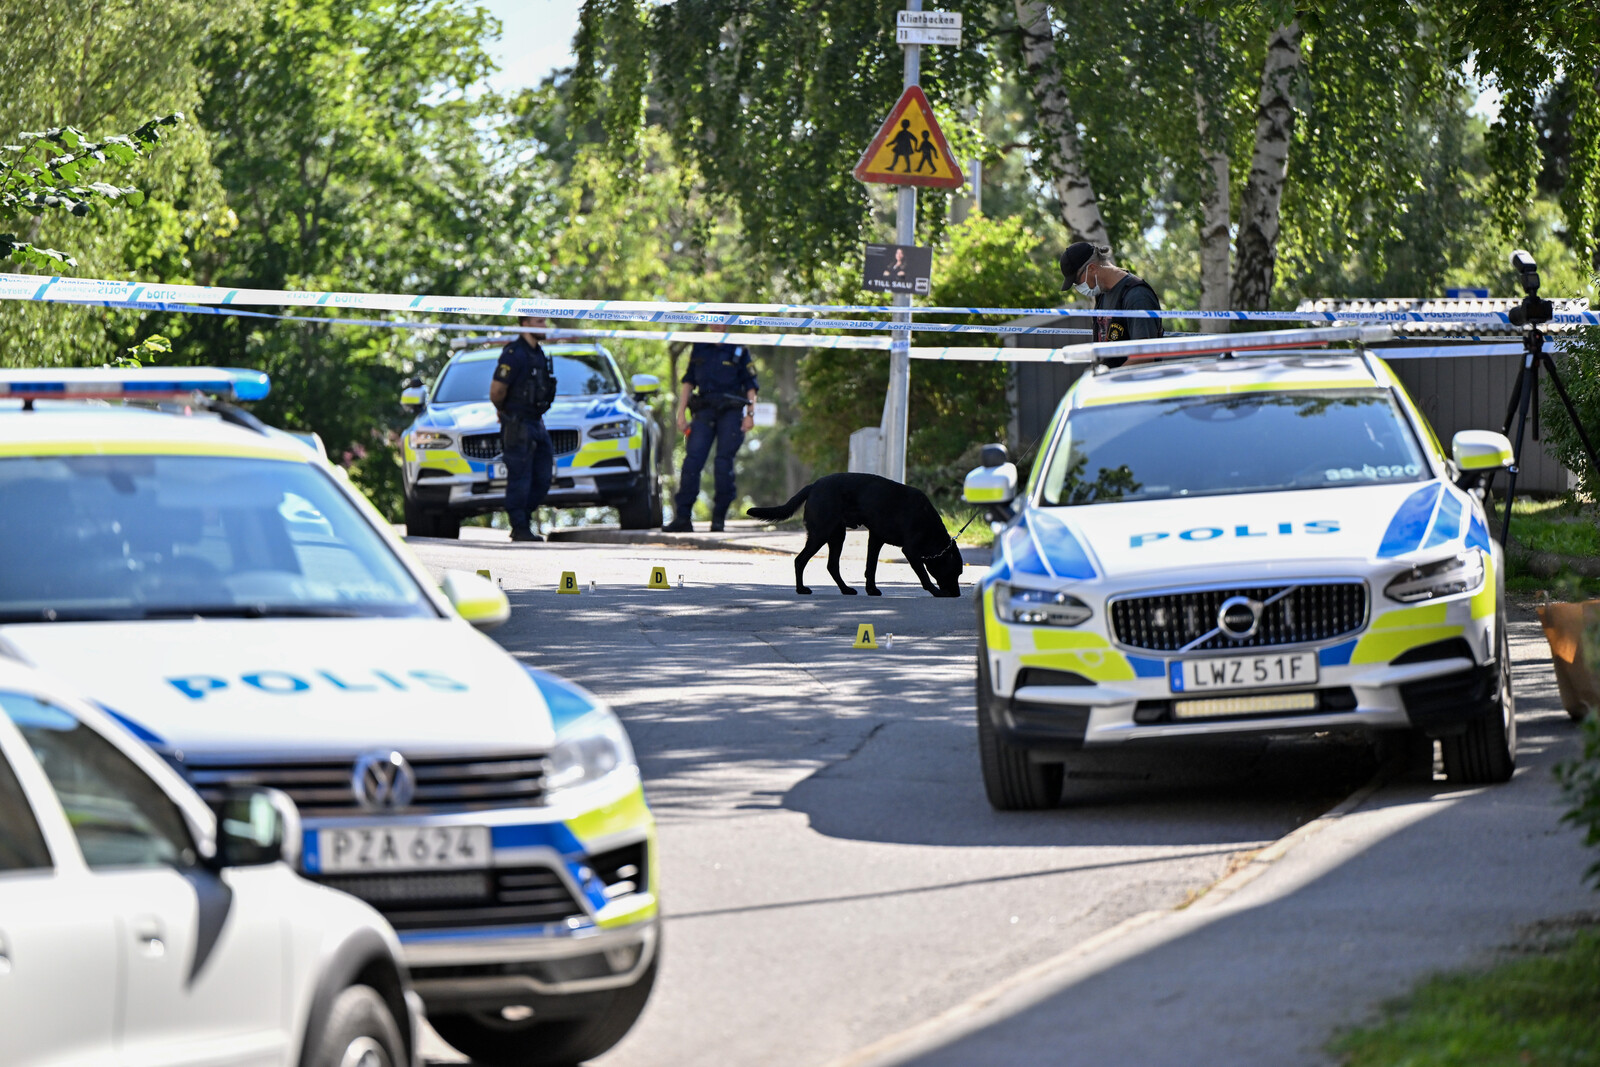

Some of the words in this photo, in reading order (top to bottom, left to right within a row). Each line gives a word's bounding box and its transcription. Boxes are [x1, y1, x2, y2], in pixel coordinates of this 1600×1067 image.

[874, 279, 890, 288] TILL
[891, 281, 913, 289] SALU
[1554, 314, 1582, 323] POLIS
[1130, 520, 1341, 548] POLIS
[566, 576, 574, 589] B
[655, 571, 663, 584] D
[862, 630, 871, 643] A
[1194, 660, 1243, 686] LWZ
[1254, 656, 1302, 682] 51F
[165, 667, 470, 701] POLIS
[332, 830, 399, 868] PZA
[409, 827, 475, 862] 624
